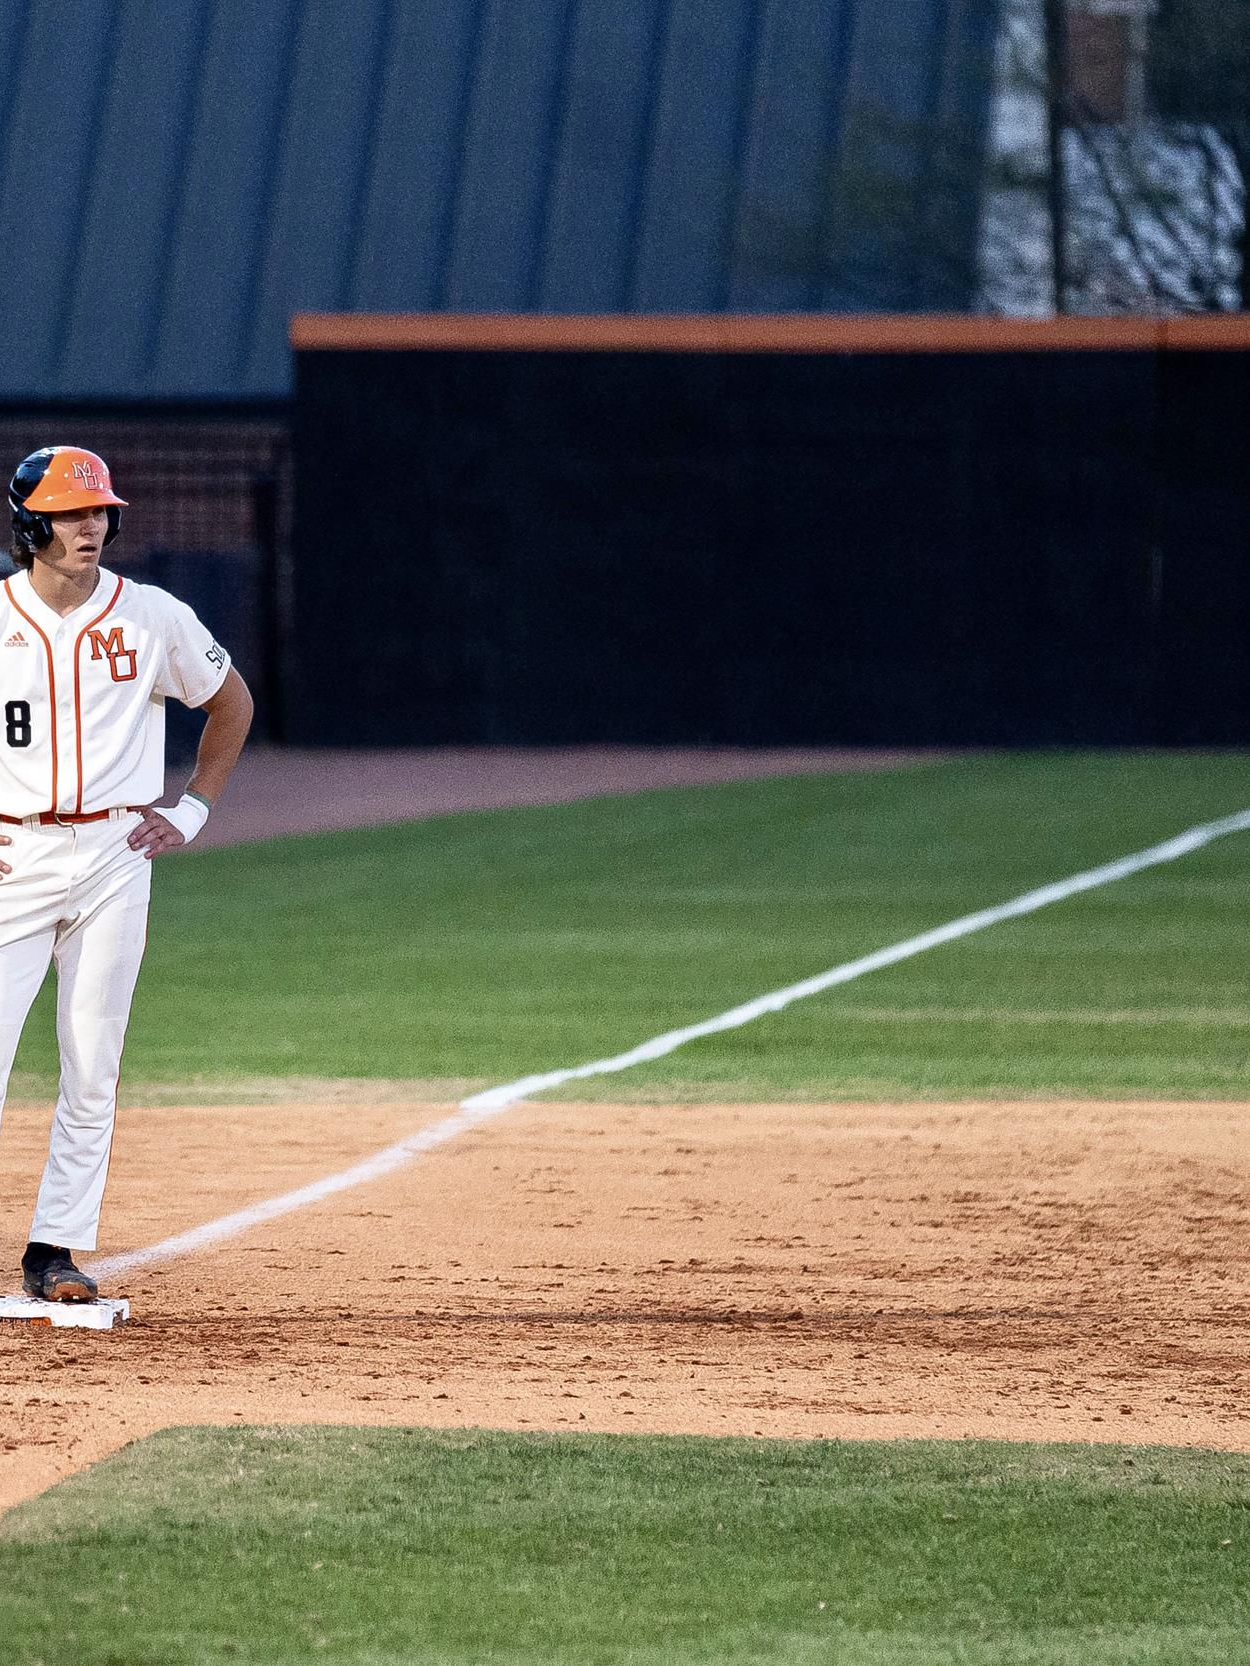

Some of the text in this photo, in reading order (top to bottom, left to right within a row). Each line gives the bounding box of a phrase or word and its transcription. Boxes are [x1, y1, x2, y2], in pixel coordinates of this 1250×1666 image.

[72, 461, 98, 490] MU
[87, 627, 137, 682] MU
[5, 700, 31, 747] 8
